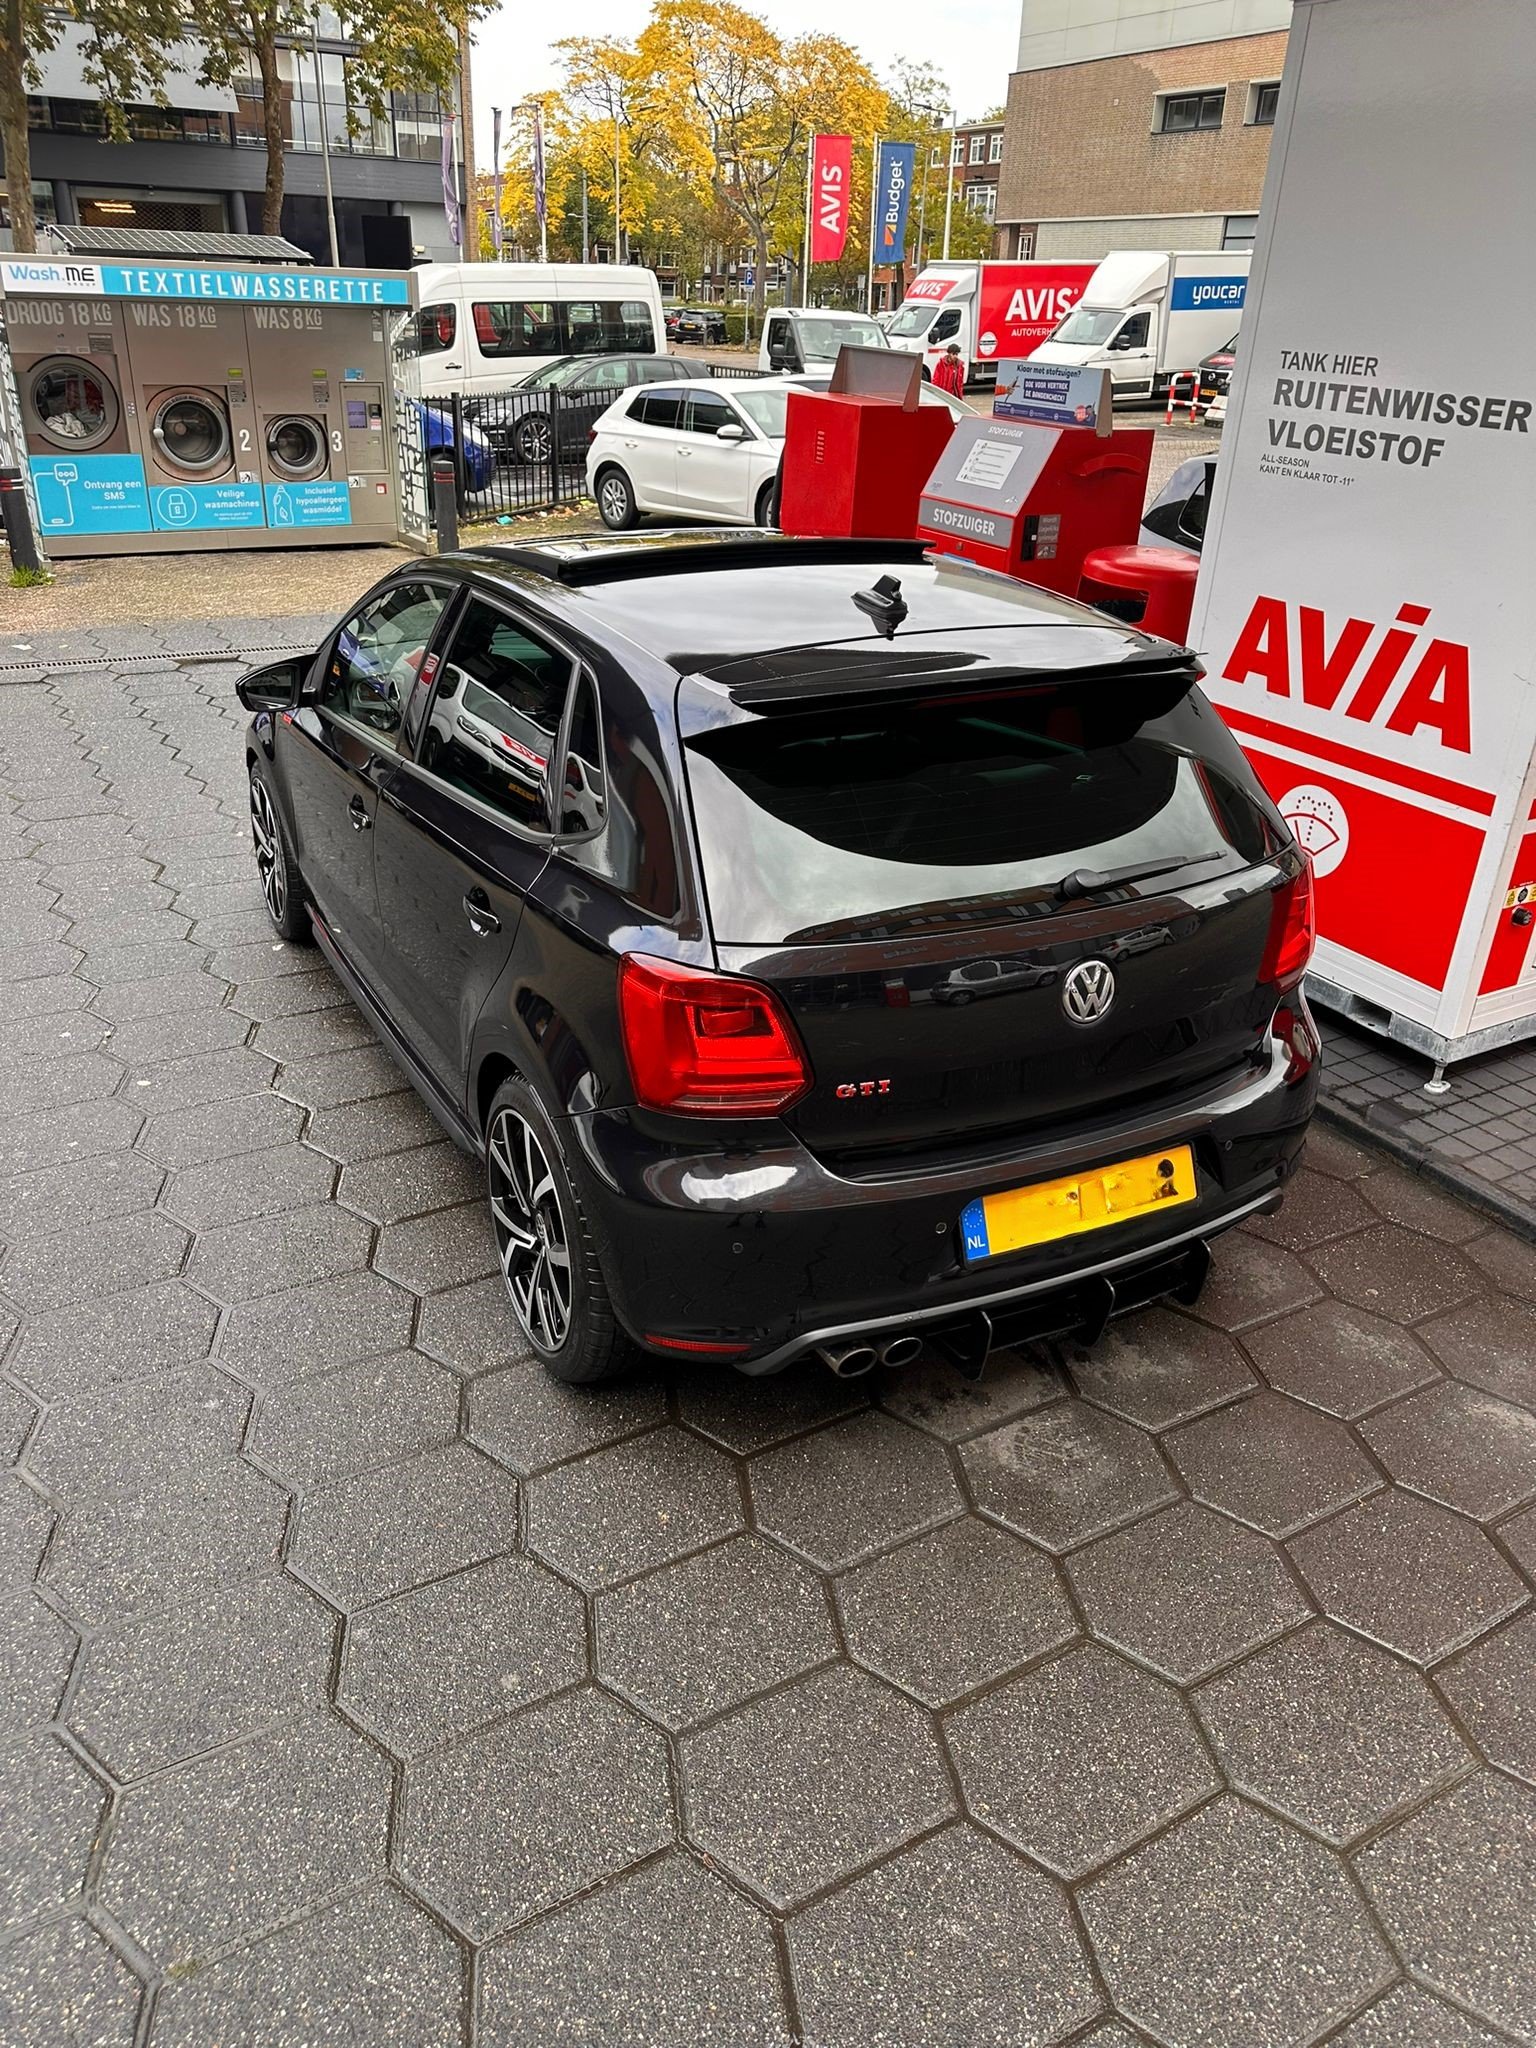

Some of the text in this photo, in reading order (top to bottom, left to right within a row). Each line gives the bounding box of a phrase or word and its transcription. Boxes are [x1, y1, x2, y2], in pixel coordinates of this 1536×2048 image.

[820, 165, 842, 234] AVIS
[885, 160, 905, 222] Budget
[121, 270, 384, 302] TEXTIELWASSERETTE
[912, 282, 945, 296] AVIS
[1192, 285, 1245, 305] youcar
[7, 301, 111, 326] DROOG 18 KG
[1004, 287, 1073, 321] AVIS
[131, 303, 217, 327] WAS 18 KG
[253, 306, 322, 329] WAS 8 KG
[1011, 327, 1053, 336] AUTOVERH
[1033, 367, 1045, 375] met
[1045, 367, 1082, 379] stofzuigen?
[1280, 350, 1378, 377] TANK HIER
[1273, 378, 1532, 433] RUITENWISSER
[239, 429, 251, 451] 2
[331, 430, 343, 452] 3
[988, 425, 1024, 438] STOFZUIGER
[1268, 418, 1445, 467] VLOEISTOF
[1261, 453, 1310, 468] ALL-SEASON
[1259, 464, 1280, 474] KANT
[1281, 467, 1292, 477] EN
[1293, 469, 1321, 481] KLAAR
[1322, 473, 1339, 484] TOT
[84, 480, 123, 490] Ontvang
[217, 489, 245, 499] Veilige
[304, 485, 336, 495] Inclusief
[104, 491, 126, 500] SMS
[204, 499, 260, 508] wasmachines
[303, 504, 342, 514] wasmiddel
[933, 507, 995, 537] STOFZUIGER
[1221, 594, 1471, 754] AVIA
[836, 1079, 890, 1098] GTI
[967, 1235, 986, 1250] NL
